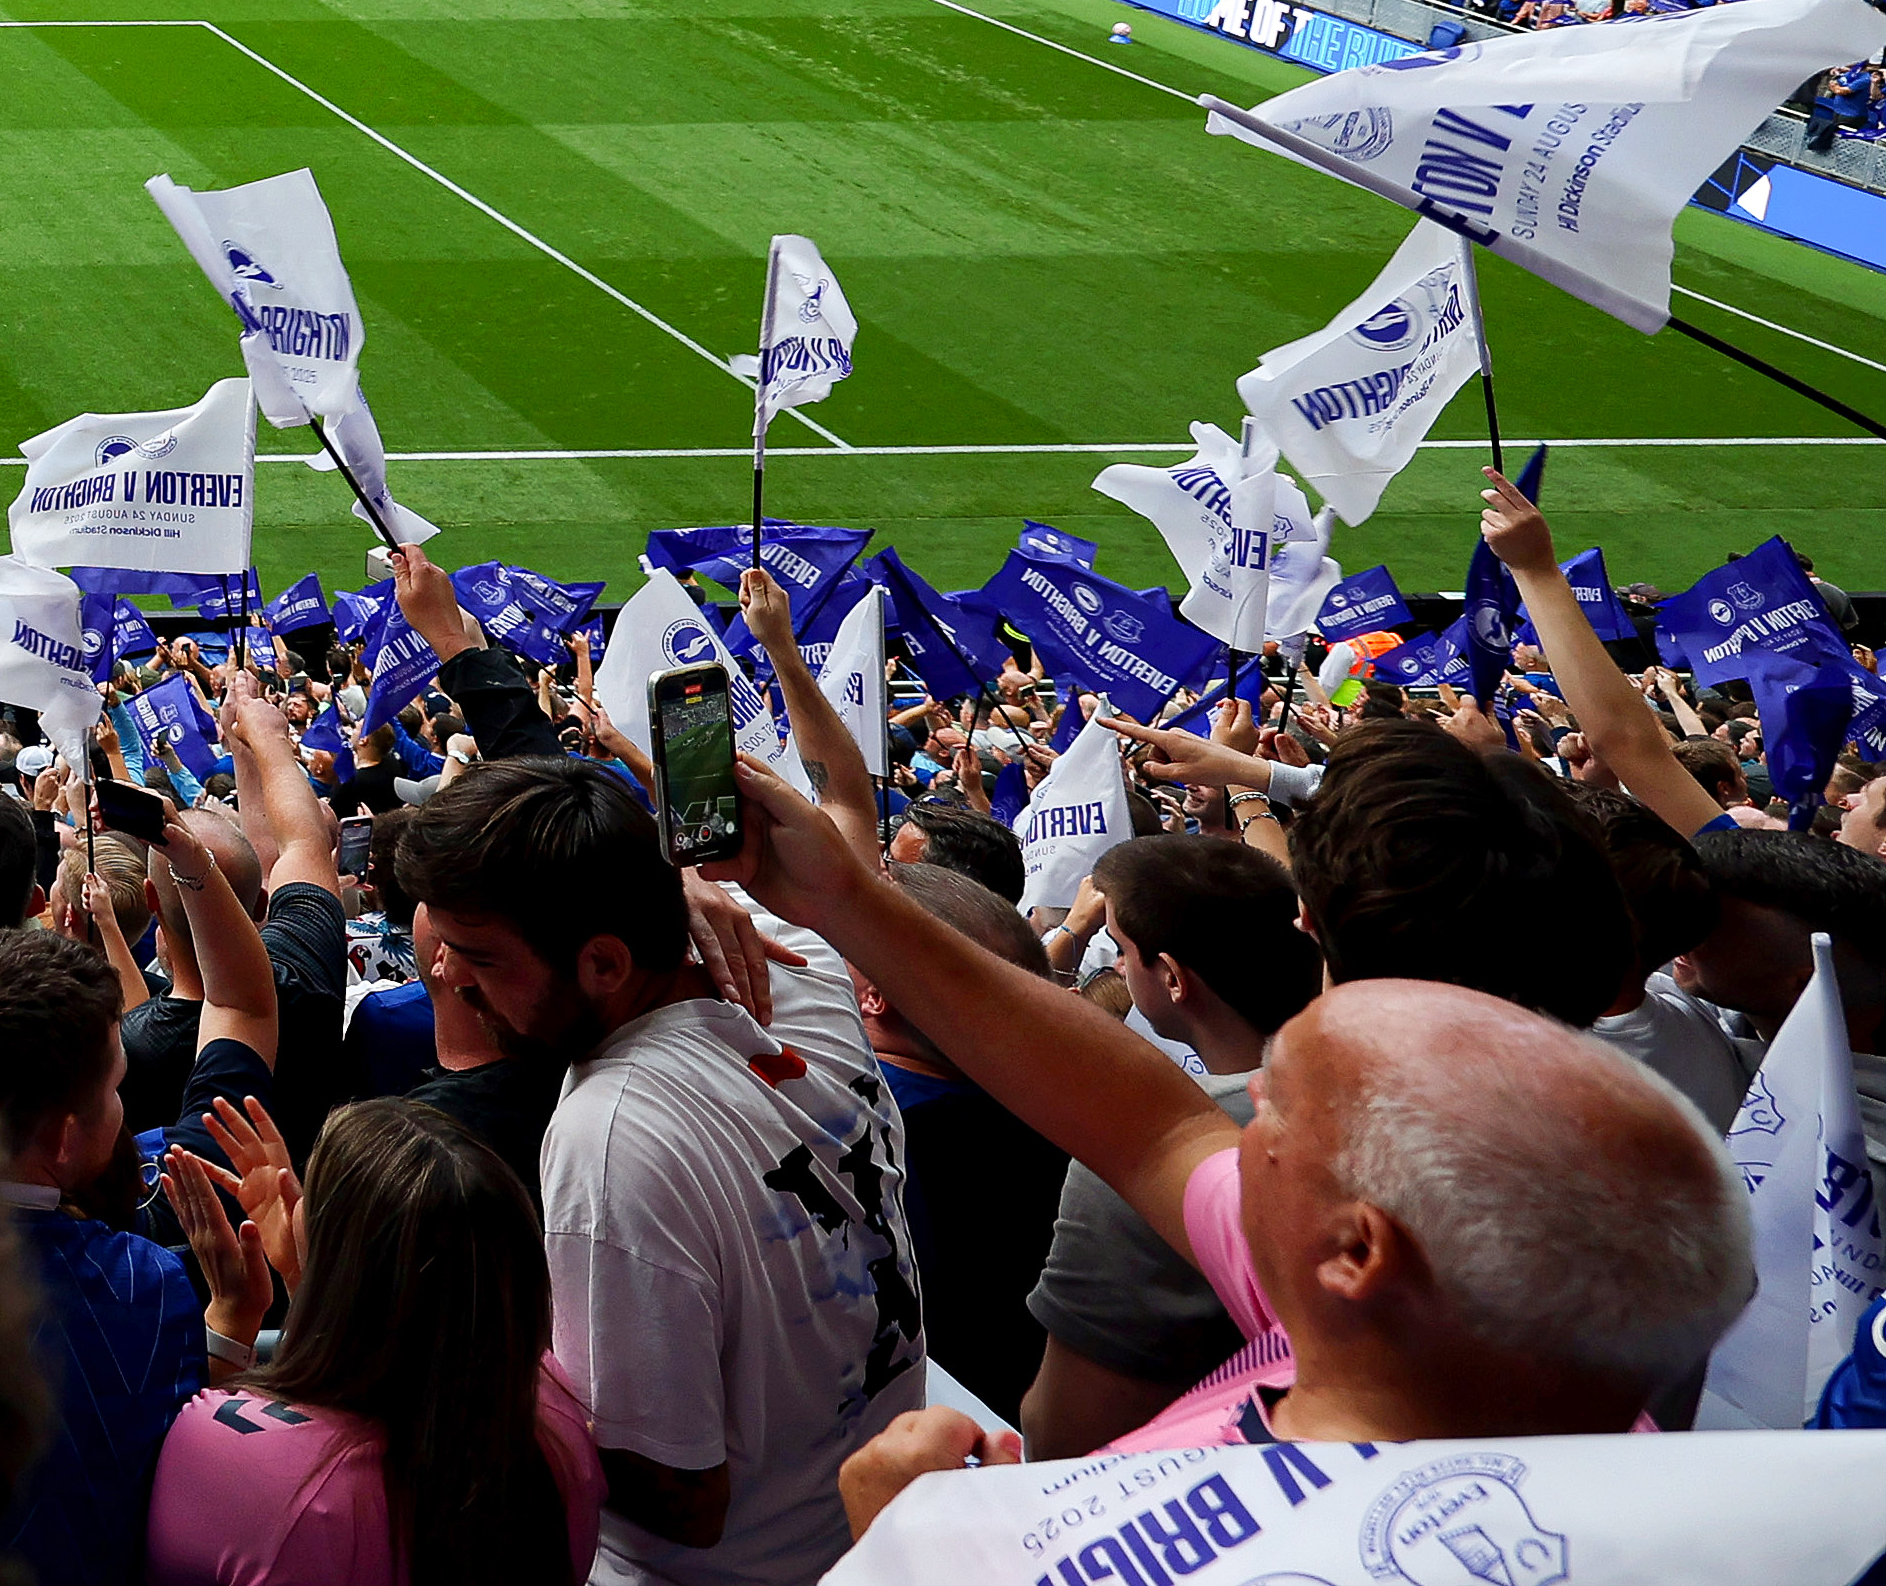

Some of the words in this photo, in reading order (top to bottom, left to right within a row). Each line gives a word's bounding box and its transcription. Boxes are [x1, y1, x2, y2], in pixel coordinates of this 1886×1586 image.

[1289, 8, 1346, 70] THE
[1527, 161, 1546, 185] 24
[1562, 143, 1605, 216] Dickinson
[1260, 1442, 1333, 1508] V
[1022, 1494, 1108, 1557] 2025
[1399, 1481, 1490, 1547] Everton
